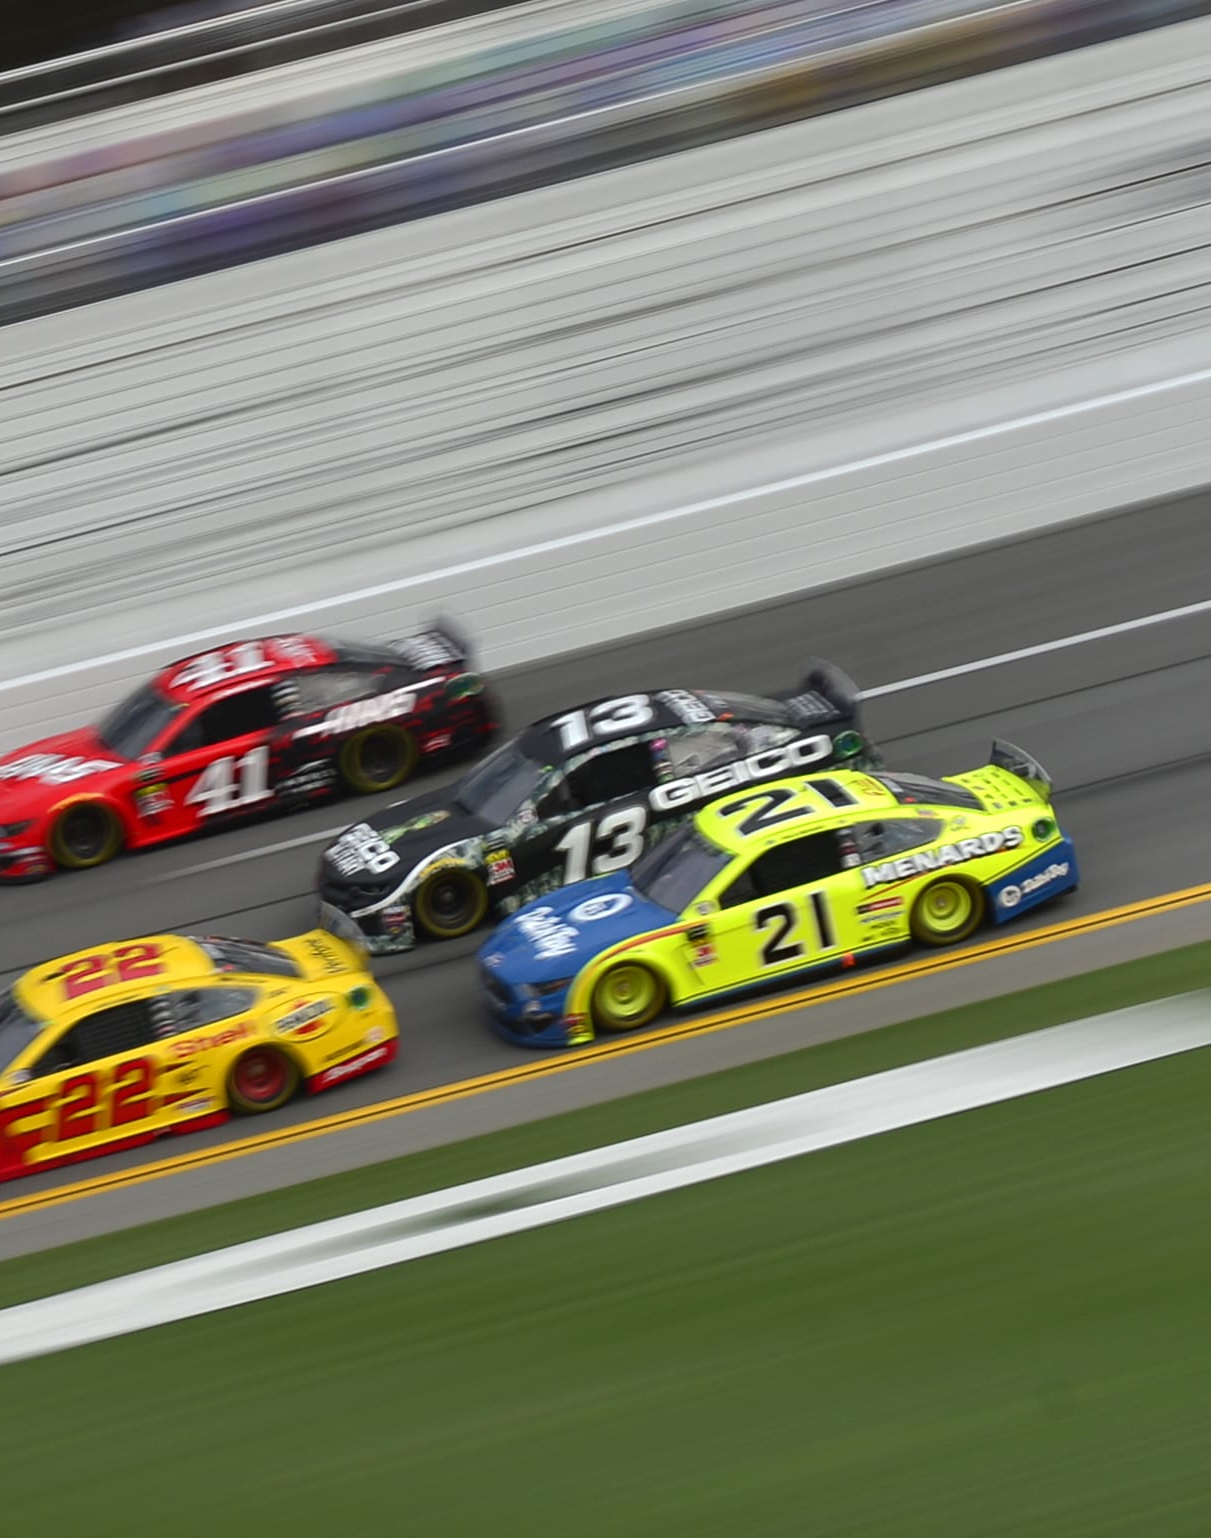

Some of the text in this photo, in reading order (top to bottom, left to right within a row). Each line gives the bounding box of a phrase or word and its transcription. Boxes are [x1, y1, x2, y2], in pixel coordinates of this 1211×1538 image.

[168, 640, 276, 691] 41
[550, 693, 654, 750] 13
[183, 745, 276, 817] 41
[648, 734, 833, 812] GEICO
[717, 777, 859, 837] 21
[555, 806, 647, 886] 13
[863, 825, 1023, 889] MENARDS
[753, 889, 837, 968] 21
[59, 942, 168, 1000] 22
[57, 1057, 152, 1142] 22
